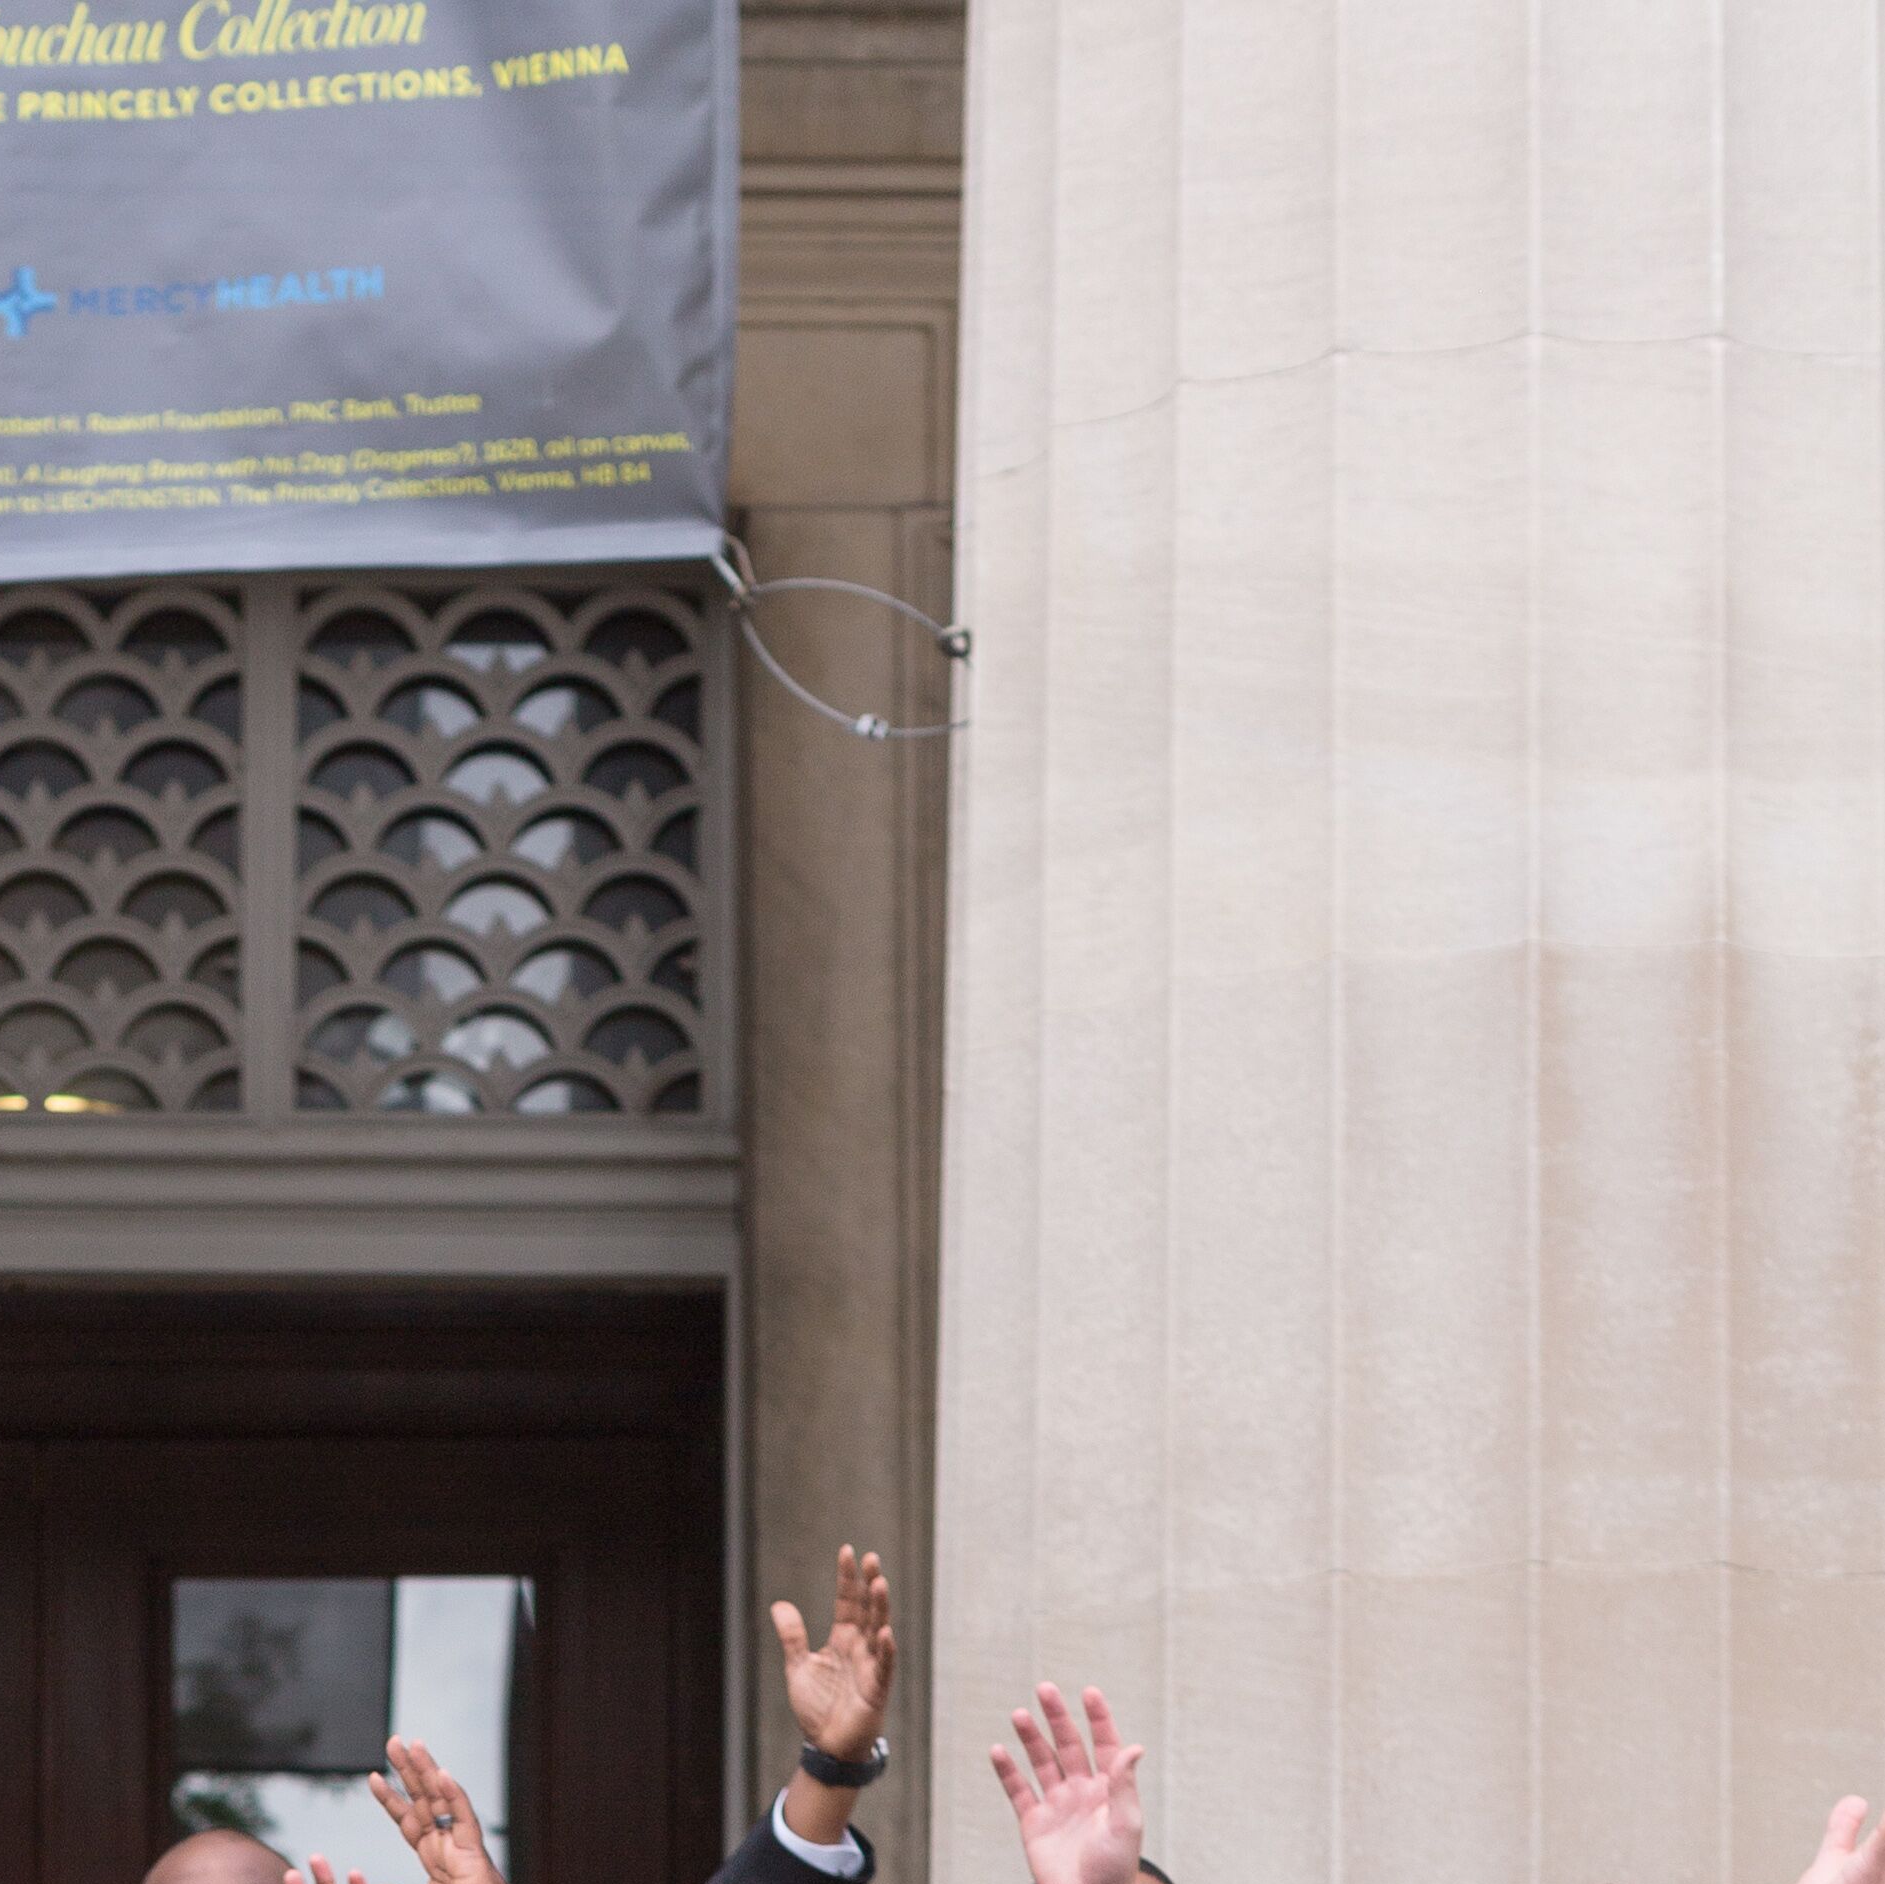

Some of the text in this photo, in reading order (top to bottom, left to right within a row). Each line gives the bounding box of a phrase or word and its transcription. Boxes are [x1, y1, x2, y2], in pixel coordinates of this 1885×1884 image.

[179, 0, 427, 59] Collection
[17, 88, 200, 119] PRINCELY
[491, 44, 629, 89] VIENNA
